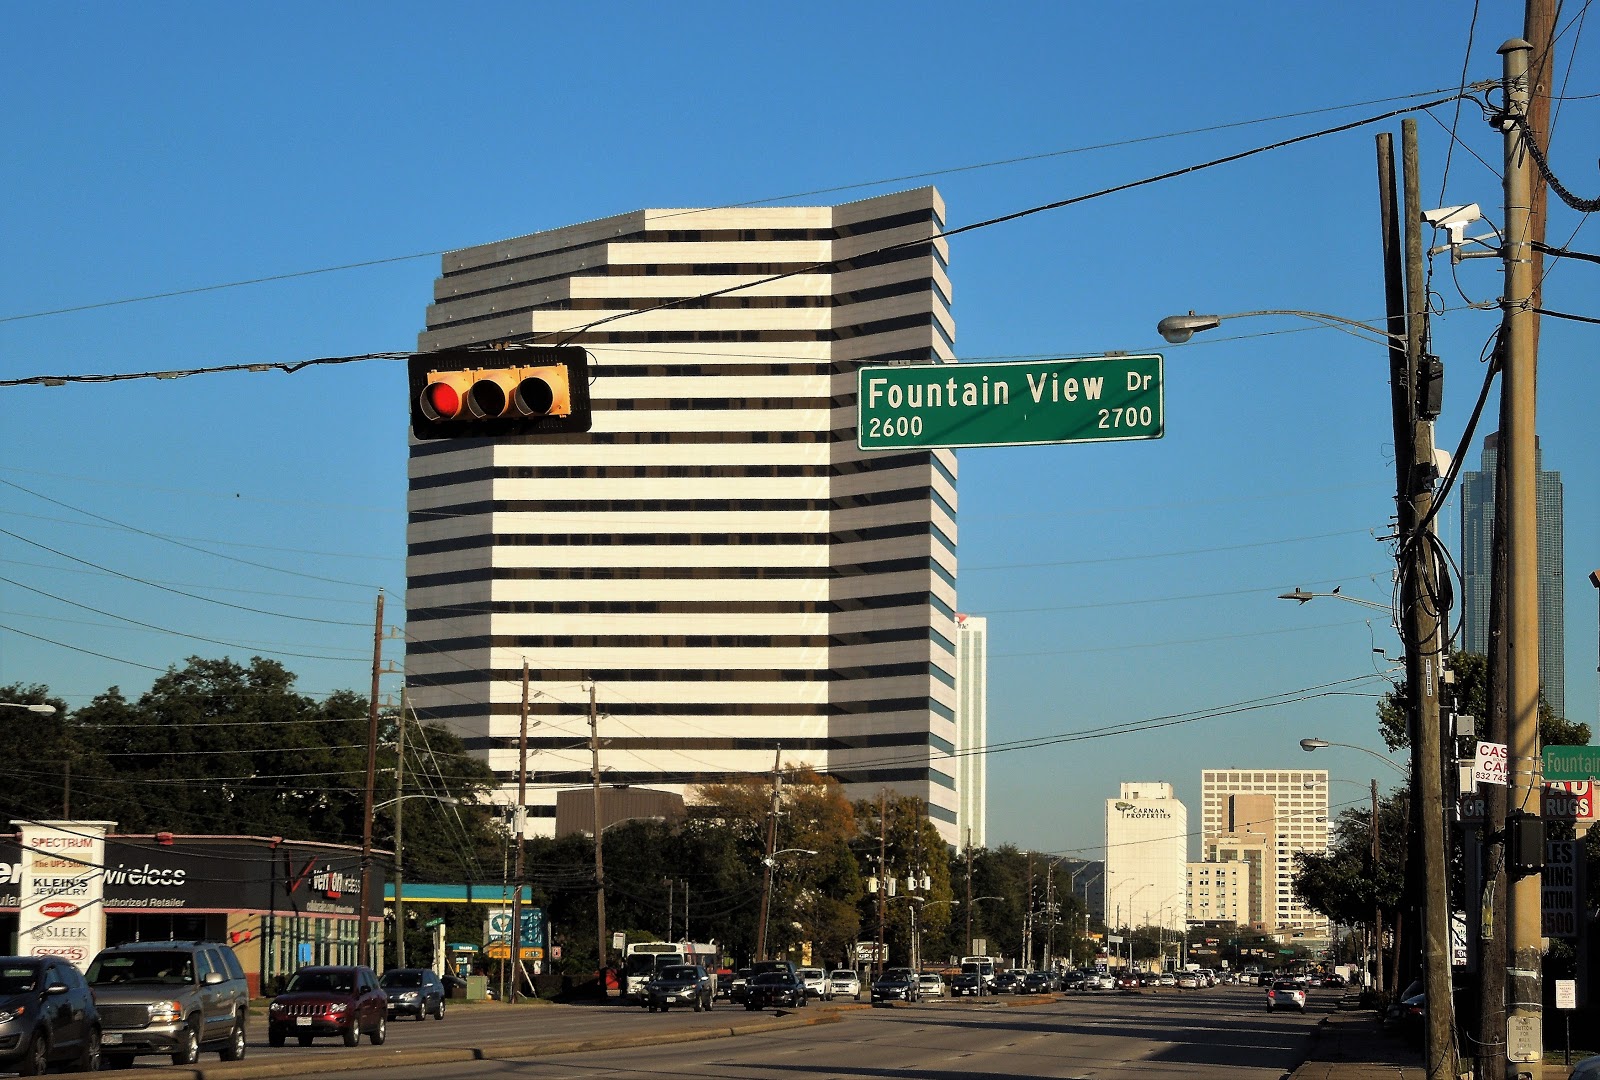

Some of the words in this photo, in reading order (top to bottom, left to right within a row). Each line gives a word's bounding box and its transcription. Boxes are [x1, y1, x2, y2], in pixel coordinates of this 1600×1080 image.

[868, 376, 1009, 409] Fountain
[1026, 372, 1104, 404] View
[1127, 371, 1152, 391] Dr
[869, 416, 923, 438] 2600
[1098, 406, 1152, 429] 2700
[1475, 771, 1491, 780] 832
[31, 838, 93, 847] SPECTRUM
[34, 860, 48, 868] The
[51, 860, 66, 868] UPS
[33, 878, 89, 887] KLEIN'S
[33, 888, 88, 896] JEWELRY
[149, 898, 185, 907] Retailer
[46, 925, 87, 938] SLEEK
